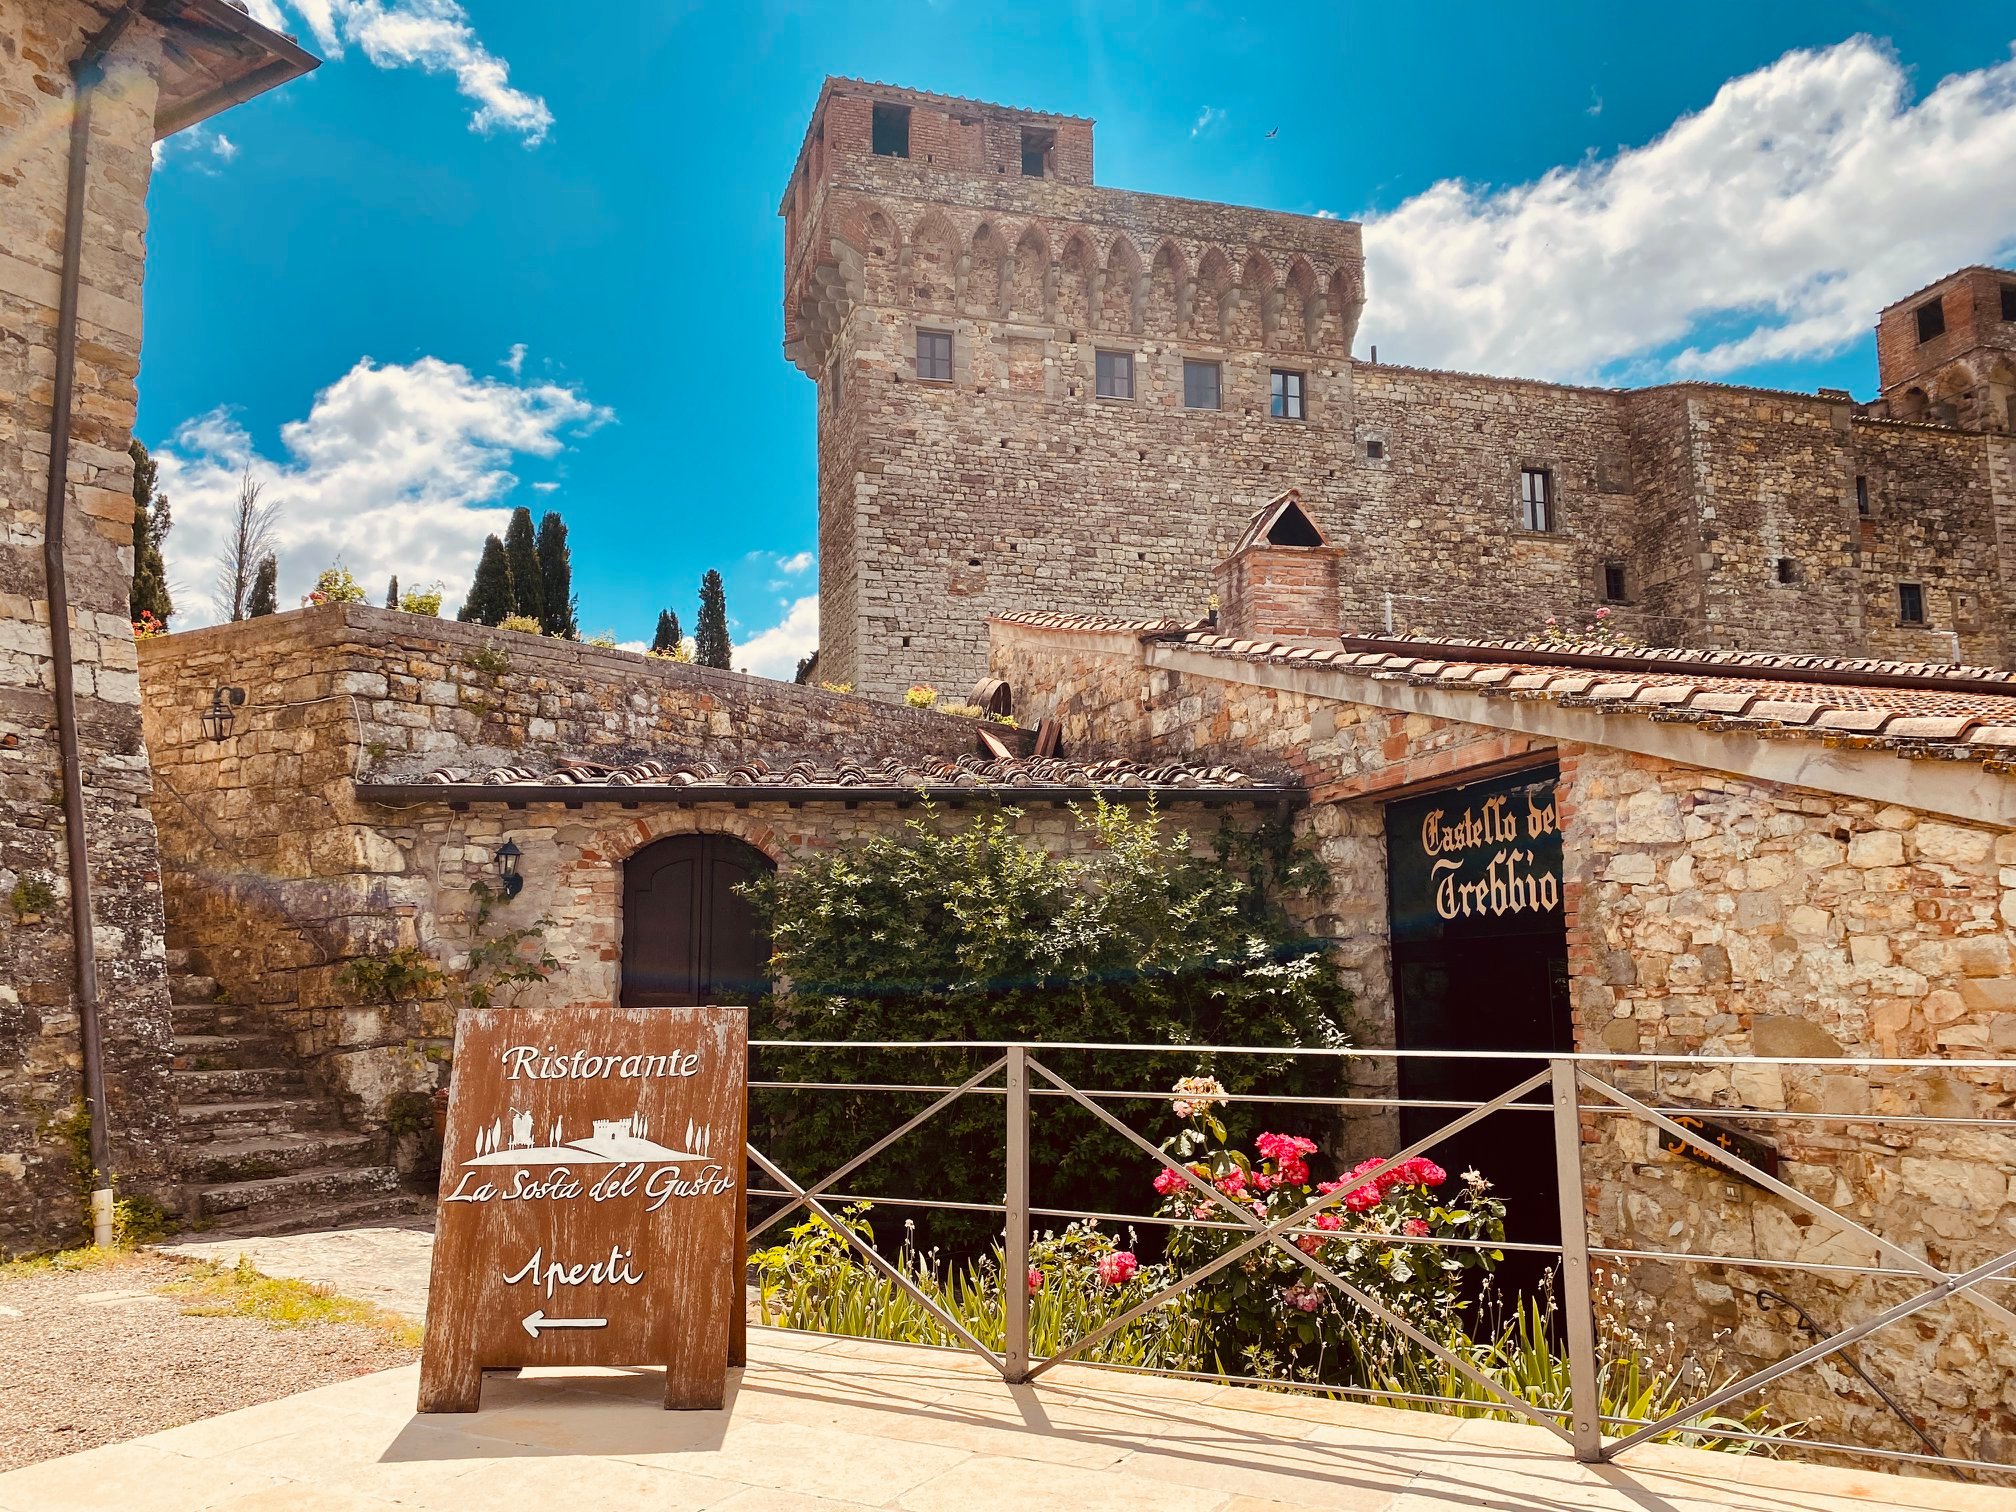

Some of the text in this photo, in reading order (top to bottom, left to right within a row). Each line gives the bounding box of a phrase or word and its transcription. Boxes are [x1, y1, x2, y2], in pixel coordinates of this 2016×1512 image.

[1422, 794, 1518, 856] Castello
[1431, 848, 1559, 920] Trebbio
[502, 1045, 699, 1081] Ristorante
[444, 1162, 735, 1212] La Sosta del Gusto
[503, 1245, 644, 1299] Aperti
